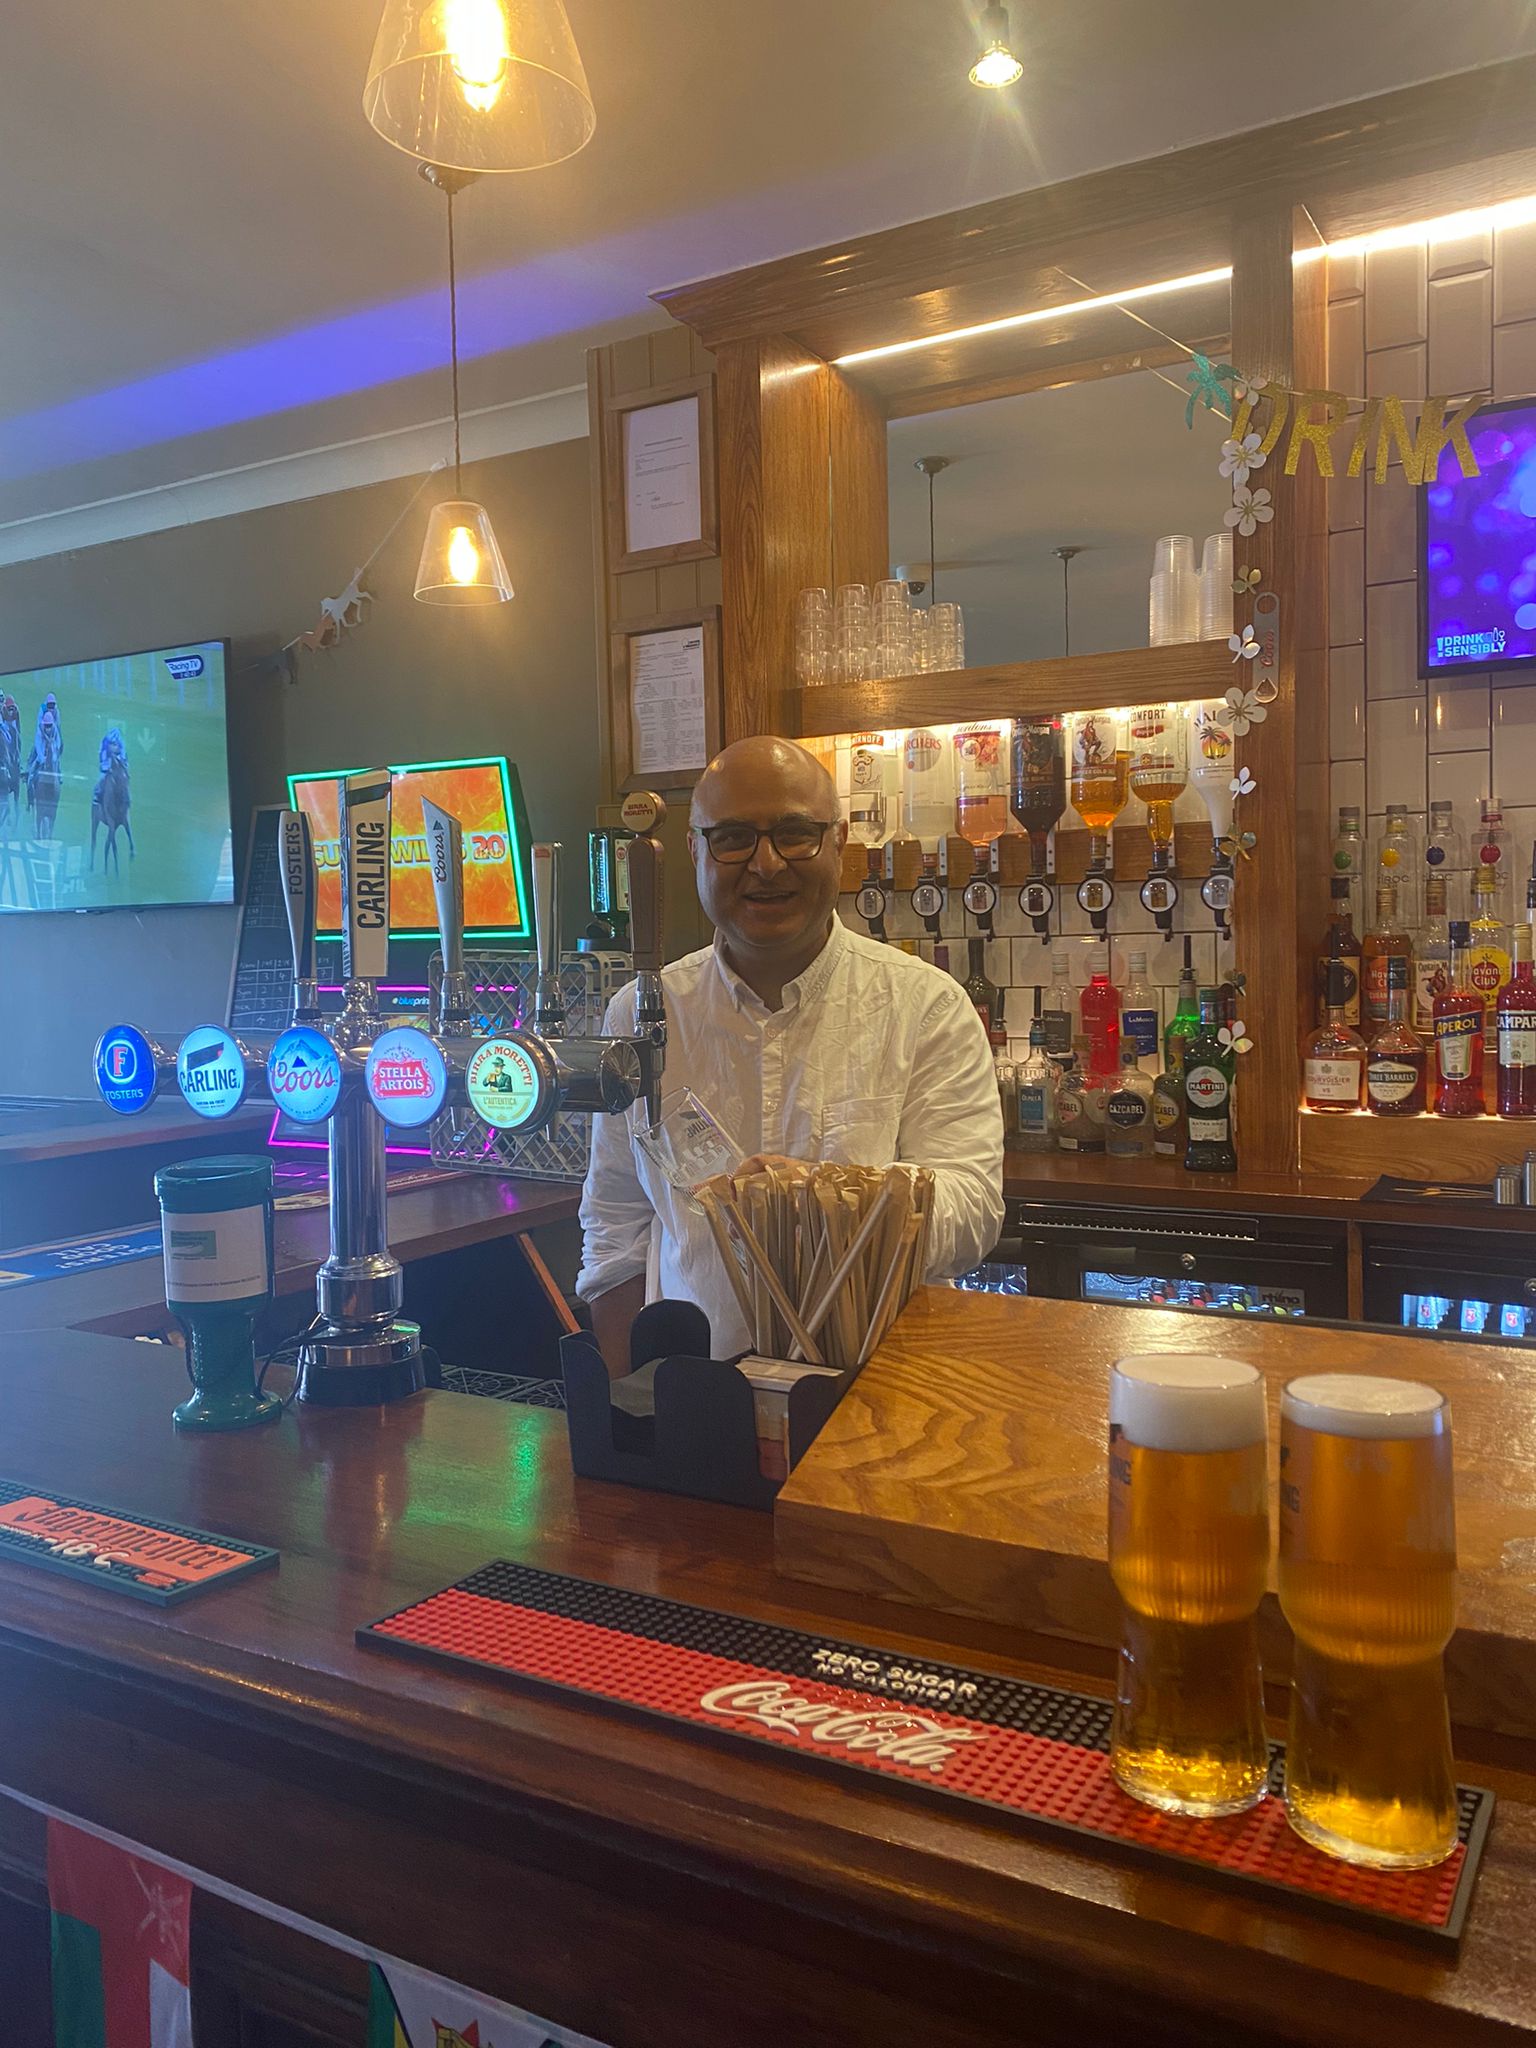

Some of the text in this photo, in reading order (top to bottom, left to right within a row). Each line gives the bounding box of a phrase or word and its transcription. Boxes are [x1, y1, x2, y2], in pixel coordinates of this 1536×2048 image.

[1231, 382, 1481, 486] DRINK
[1444, 632, 1484, 647] DRINK
[1444, 641, 1507, 657] SENSIBLY
[433, 831, 446, 883] Coors
[471, 834, 505, 861] 20
[285, 821, 304, 895] FOSTER'S
[356, 822, 385, 929] CARLING
[1474, 976, 1497, 986] Club
[398, 996, 430, 1007] blueprin
[1436, 1017, 1478, 1037] APEROL
[1496, 1016, 1536, 1029] CAMPAR
[379, 1066, 423, 1078] STELLA
[470, 1049, 493, 1084] BIRRA
[494, 1046, 533, 1086] MORETTI
[180, 1068, 239, 1094] CARLING
[271, 1061, 336, 1094] Coors
[381, 1079, 425, 1090] ARTOIS
[1189, 1083, 1225, 1091] MARTINI
[105, 1088, 144, 1100] FOSTER'S
[1109, 1103, 1145, 1115] CAZCABEL
[811, 1648, 978, 1699] ZERO SUGAR
[816, 1661, 845, 1676] NO
[700, 1681, 990, 1770] Coca-Cola
